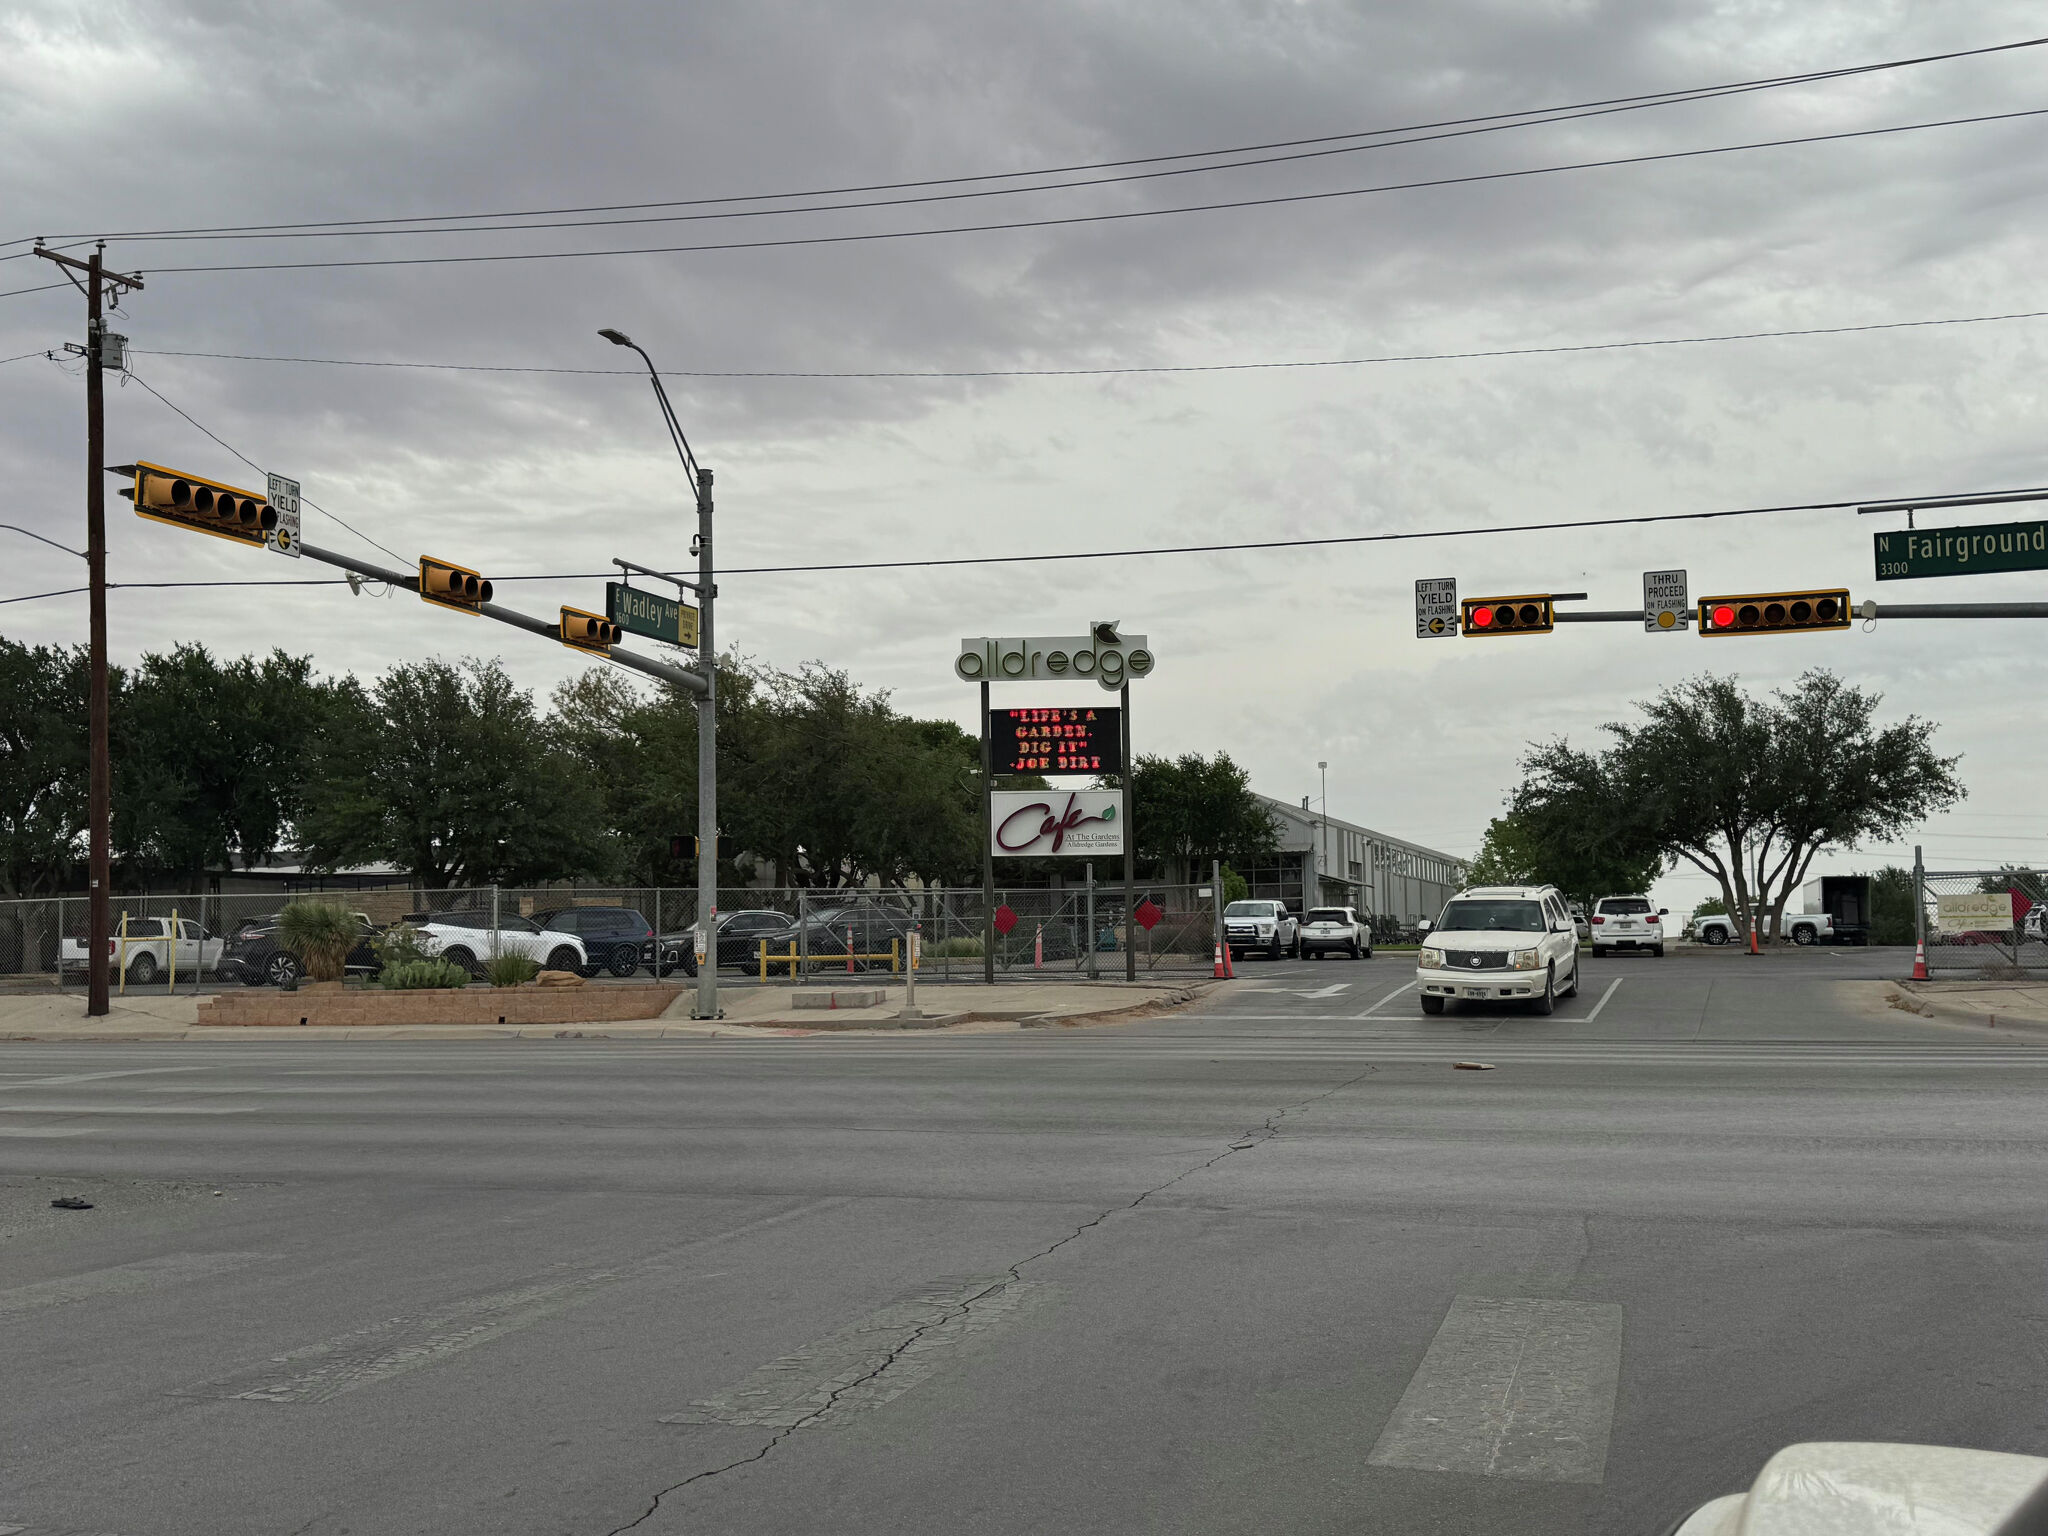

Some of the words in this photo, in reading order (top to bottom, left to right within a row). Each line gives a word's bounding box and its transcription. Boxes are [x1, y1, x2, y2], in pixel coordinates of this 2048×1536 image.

[268, 477, 281, 492] LEFT
[285, 483, 299, 498] TURN
[271, 492, 297, 513] YIELD
[1879, 536, 1889, 552] N
[1908, 525, 2045, 563] Fairground
[1880, 561, 1908, 576] 3300
[1652, 573, 1678, 585] THRU
[1417, 582, 1433, 592] LEFT
[1438, 581, 1454, 591] TURN
[1648, 585, 1685, 598] PROCEED
[1420, 592, 1453, 605] YIELD
[1647, 601, 1655, 609] ON
[1657, 599, 1685, 610] FLASHING
[615, 588, 620, 603] E
[623, 592, 662, 628] Wadley
[665, 603, 677, 619] Ave
[1418, 608, 1426, 616] ON
[1427, 604, 1455, 616] FLASHING
[958, 627, 1151, 686] alldredge
[1085, 709, 1098, 721] A
[1018, 741, 1052, 753] DIG
[1057, 756, 1101, 769] DIRT
[1065, 833, 1075, 841] At
[1091, 832, 1120, 840] Gardens
[1943, 897, 2006, 916] alldredge
